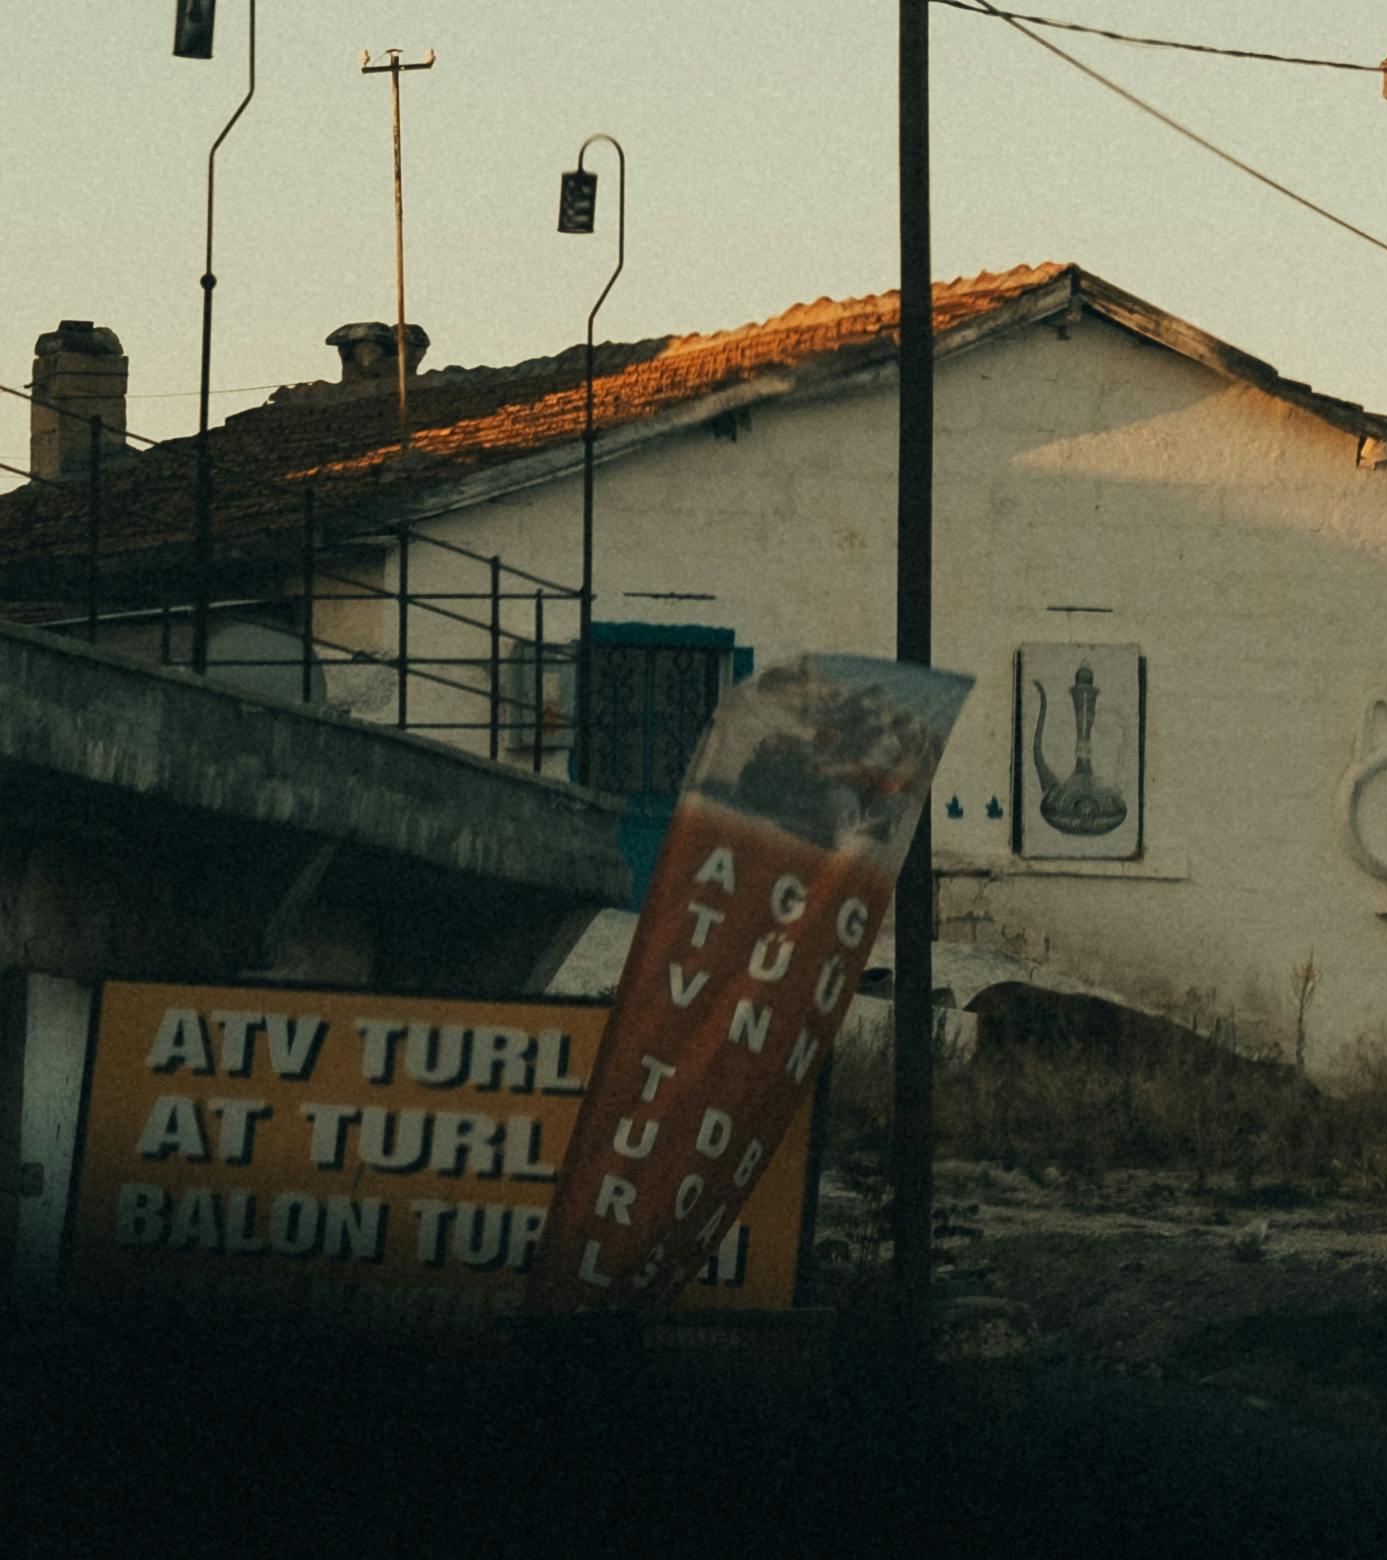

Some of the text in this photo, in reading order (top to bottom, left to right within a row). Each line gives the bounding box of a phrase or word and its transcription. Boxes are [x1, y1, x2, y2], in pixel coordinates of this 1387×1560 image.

[669, 846, 736, 1008] ATV
[728, 873, 807, 1053] GÜN
[146, 1008, 327, 1078] ATV
[136, 1095, 270, 1161] AT
[115, 1183, 388, 1264] BALON
